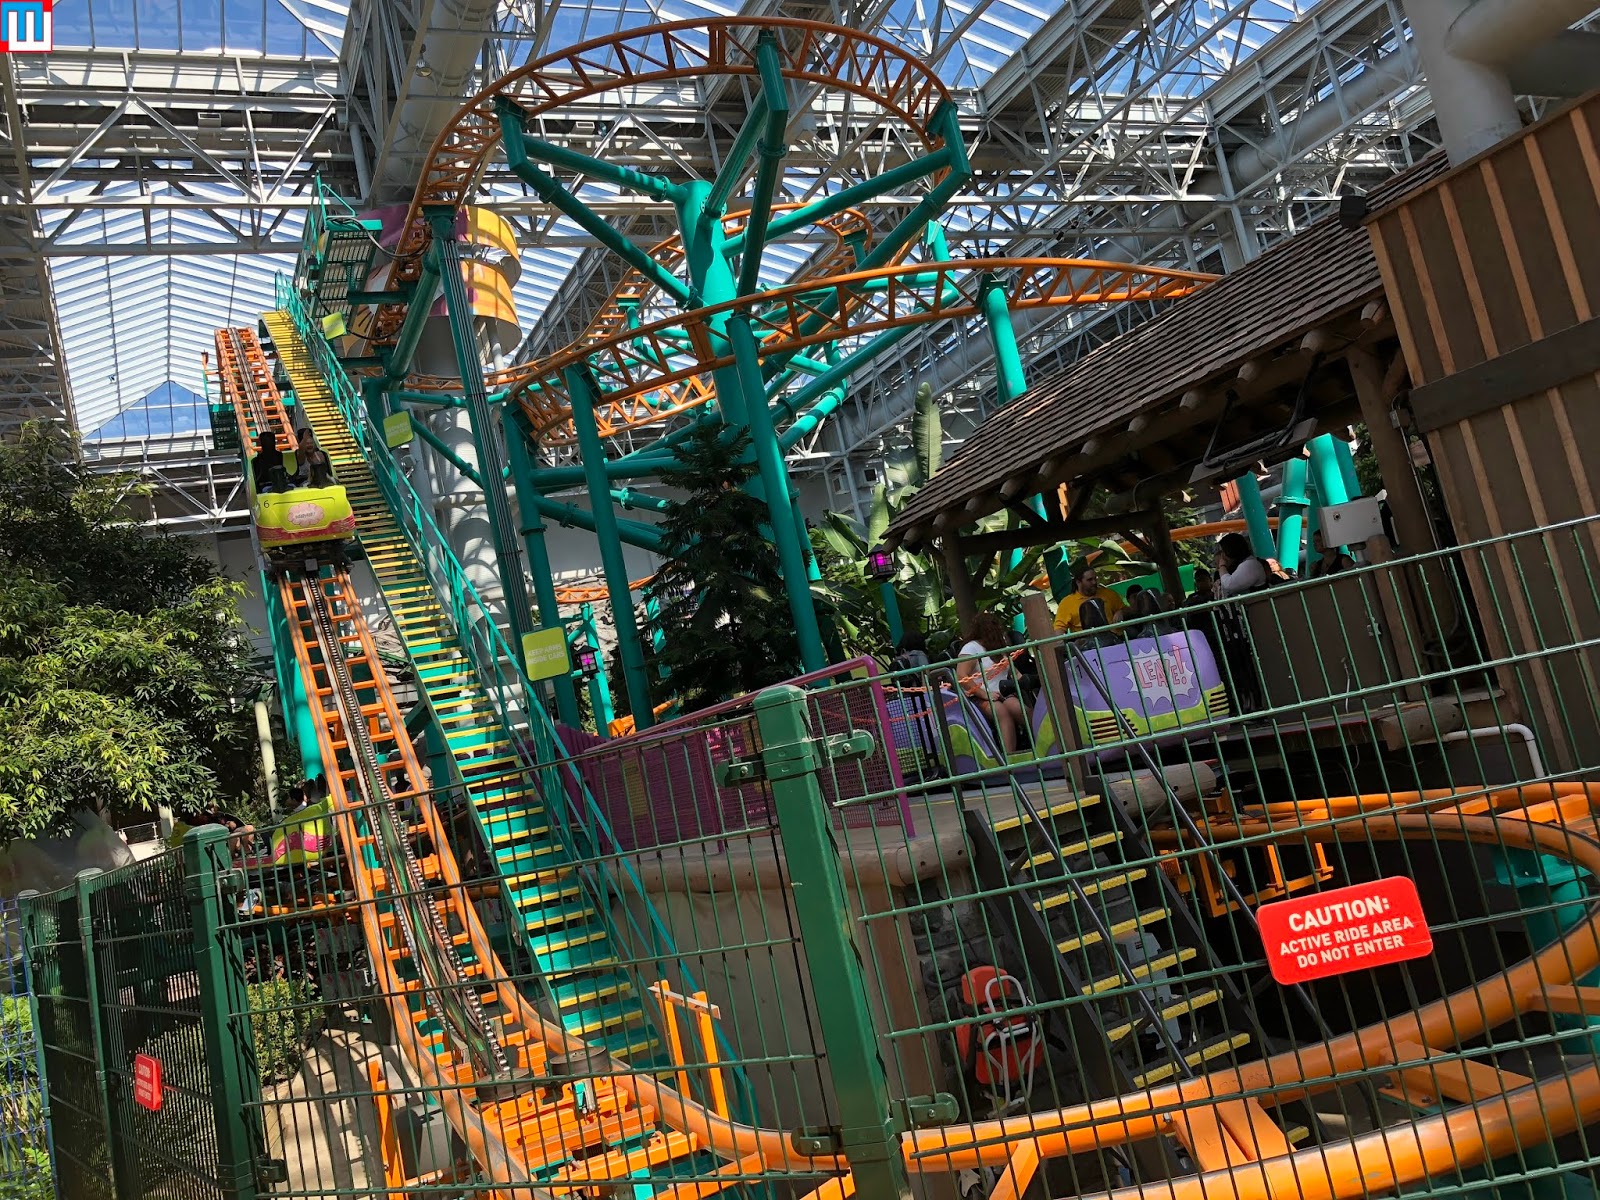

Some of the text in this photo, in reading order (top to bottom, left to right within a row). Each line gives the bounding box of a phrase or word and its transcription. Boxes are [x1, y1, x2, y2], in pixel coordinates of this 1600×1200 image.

[263, 500, 270, 508] 6
[1135, 645, 1188, 689] LEAVE!
[1288, 896, 1390, 932] CAUTION:
[1280, 916, 1414, 956] ACTIVE RIDE AREA
[1297, 935, 1405, 969] DO NOT ENTER
